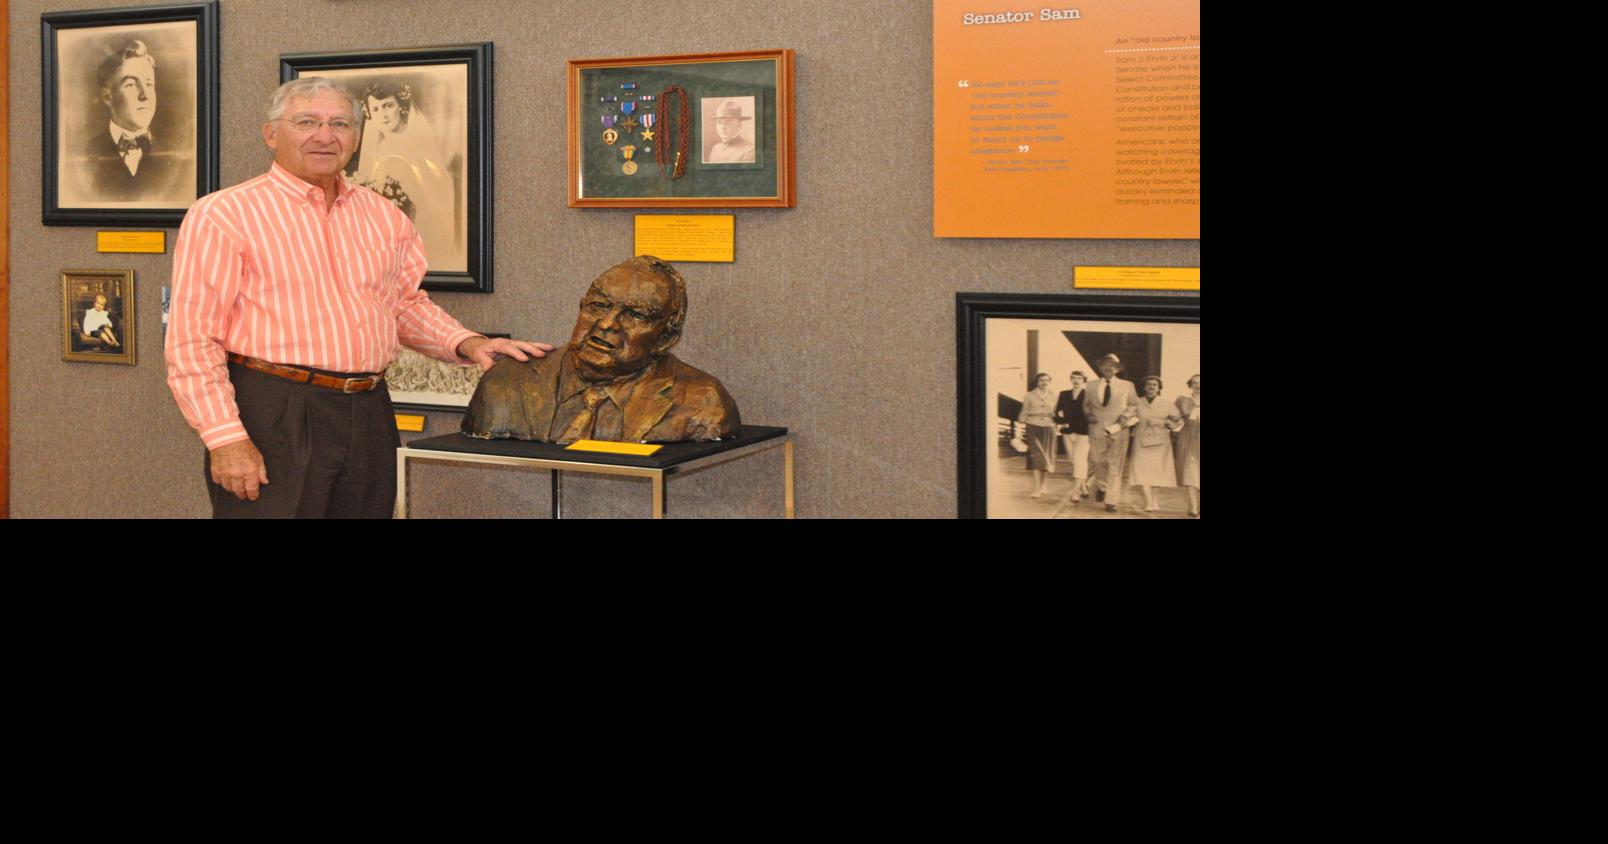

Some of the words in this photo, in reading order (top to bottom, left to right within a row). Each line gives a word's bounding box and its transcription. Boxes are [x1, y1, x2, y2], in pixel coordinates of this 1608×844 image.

[963, 11, 1034, 25] Senator
[1040, 8, 1081, 21] Sam
[1152, 35, 1188, 43] country
[1115, 56, 1136, 64] Sam
[1115, 66, 1148, 74] Senate
[1146, 74, 1199, 82] Committee
[1115, 85, 1169, 93] Constitution
[1155, 94, 1189, 102] powers
[1127, 104, 1160, 112] checks
[1115, 158, 1149, 166] tivated
[1151, 158, 1162, 166] by
[1115, 168, 1157, 176] Although
[1115, 178, 1150, 186] country
[1115, 188, 1147, 196] quickly
[1149, 187, 1195, 195] reminded
[1115, 198, 1150, 206] training
